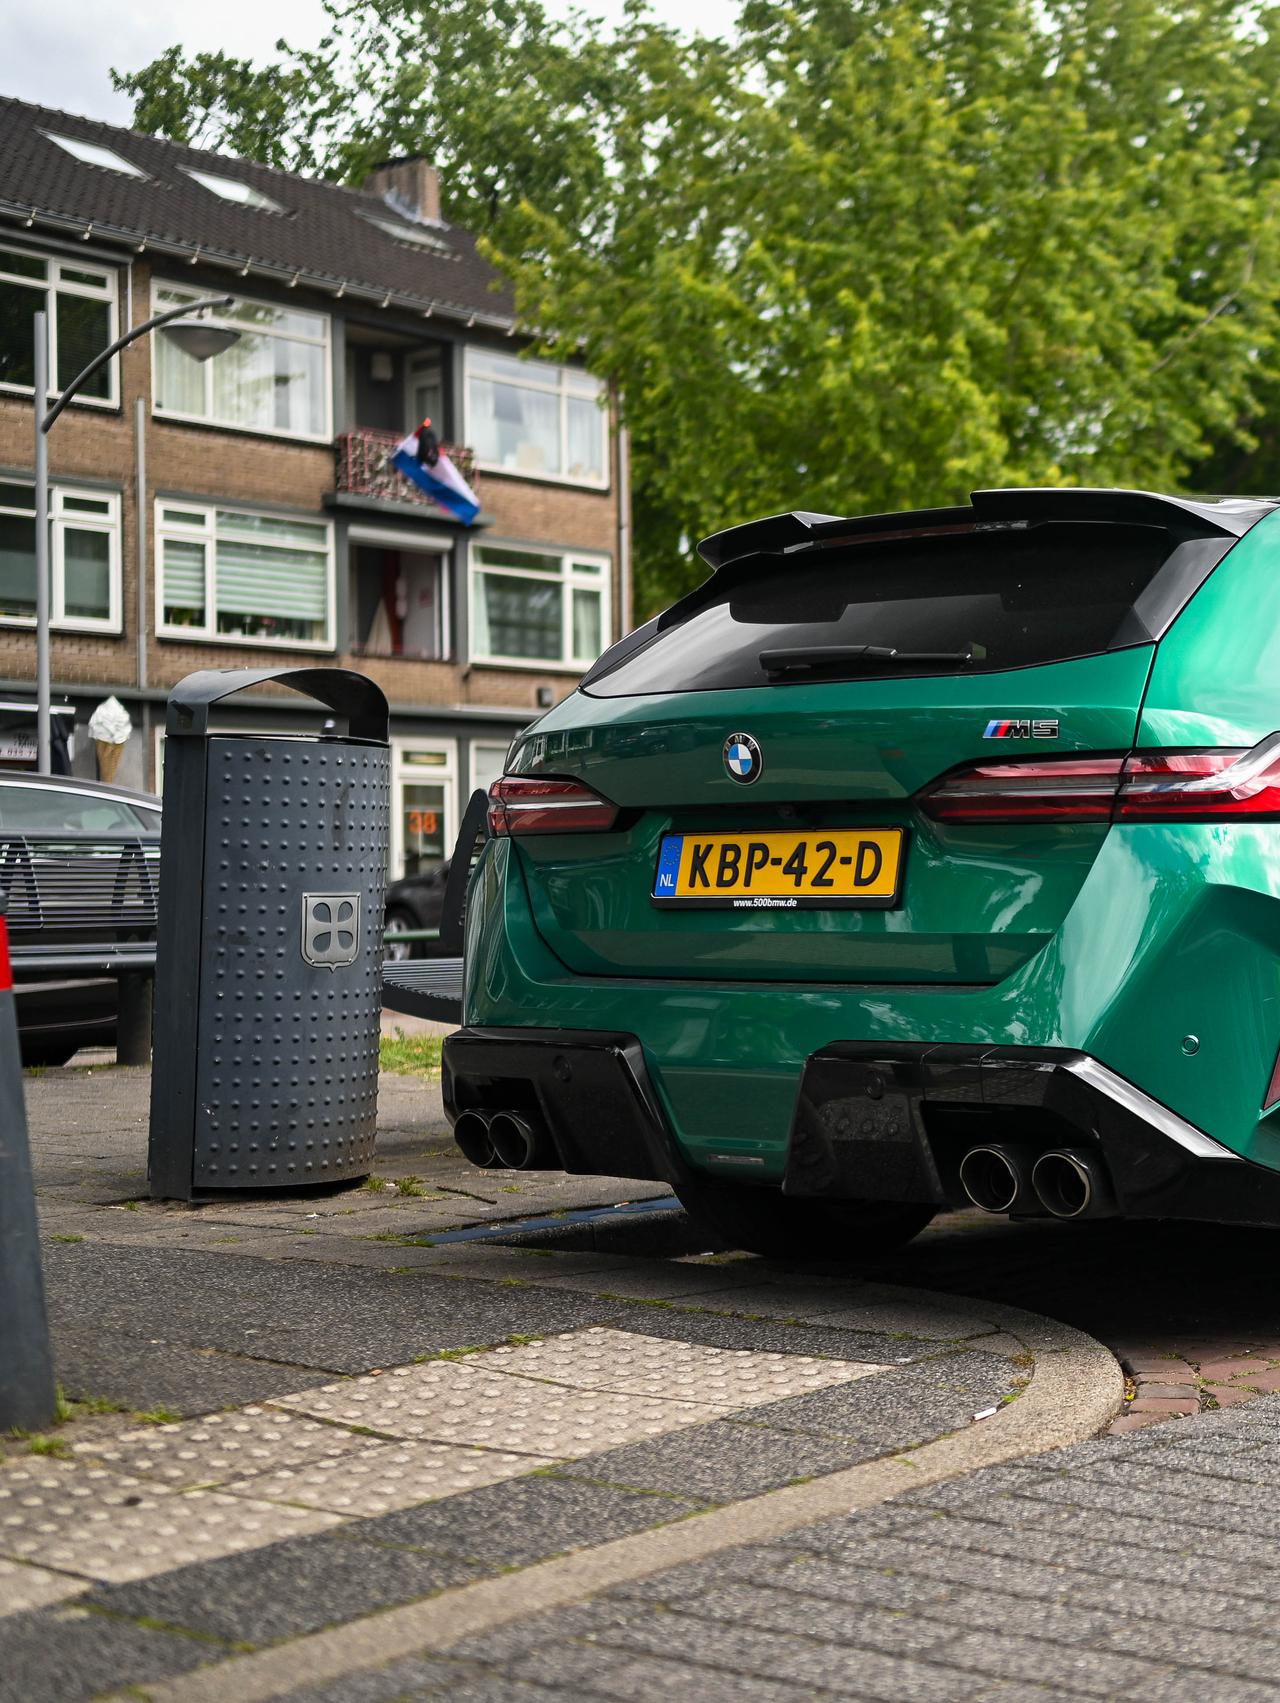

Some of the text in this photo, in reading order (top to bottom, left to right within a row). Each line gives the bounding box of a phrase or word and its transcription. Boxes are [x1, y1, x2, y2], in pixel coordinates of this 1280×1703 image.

[996, 719, 1059, 739] M5
[724, 734, 757, 751] BMW
[409, 809, 437, 835] 38
[688, 840, 883, 888] KBP-42-D
[659, 873, 675, 888] NL
[733, 898, 798, 908] www.500bmw.de
